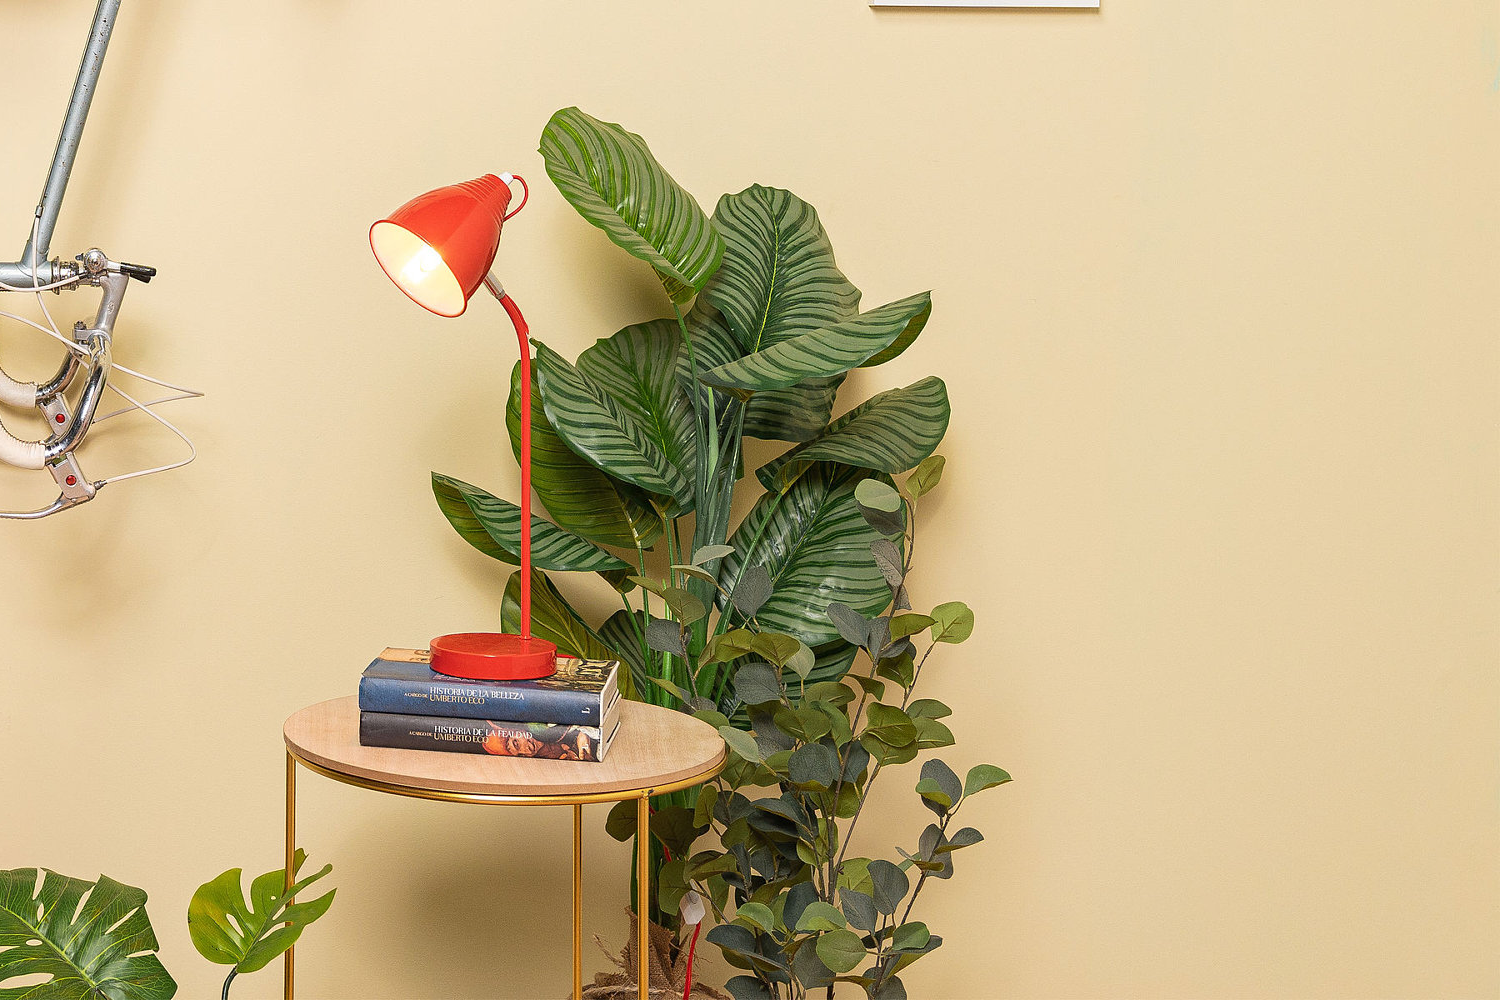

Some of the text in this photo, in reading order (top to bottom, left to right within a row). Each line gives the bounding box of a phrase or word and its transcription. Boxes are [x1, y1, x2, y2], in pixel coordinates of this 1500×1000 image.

[430, 687, 524, 700] HISTORIA DE LA BELLEZA
[430, 695, 485, 705] UMBERTO ECO
[434, 725, 471, 735] HISTORIA
[498, 730, 532, 739] FEALDAD
[434, 733, 489, 743] UMBERTO ECO
